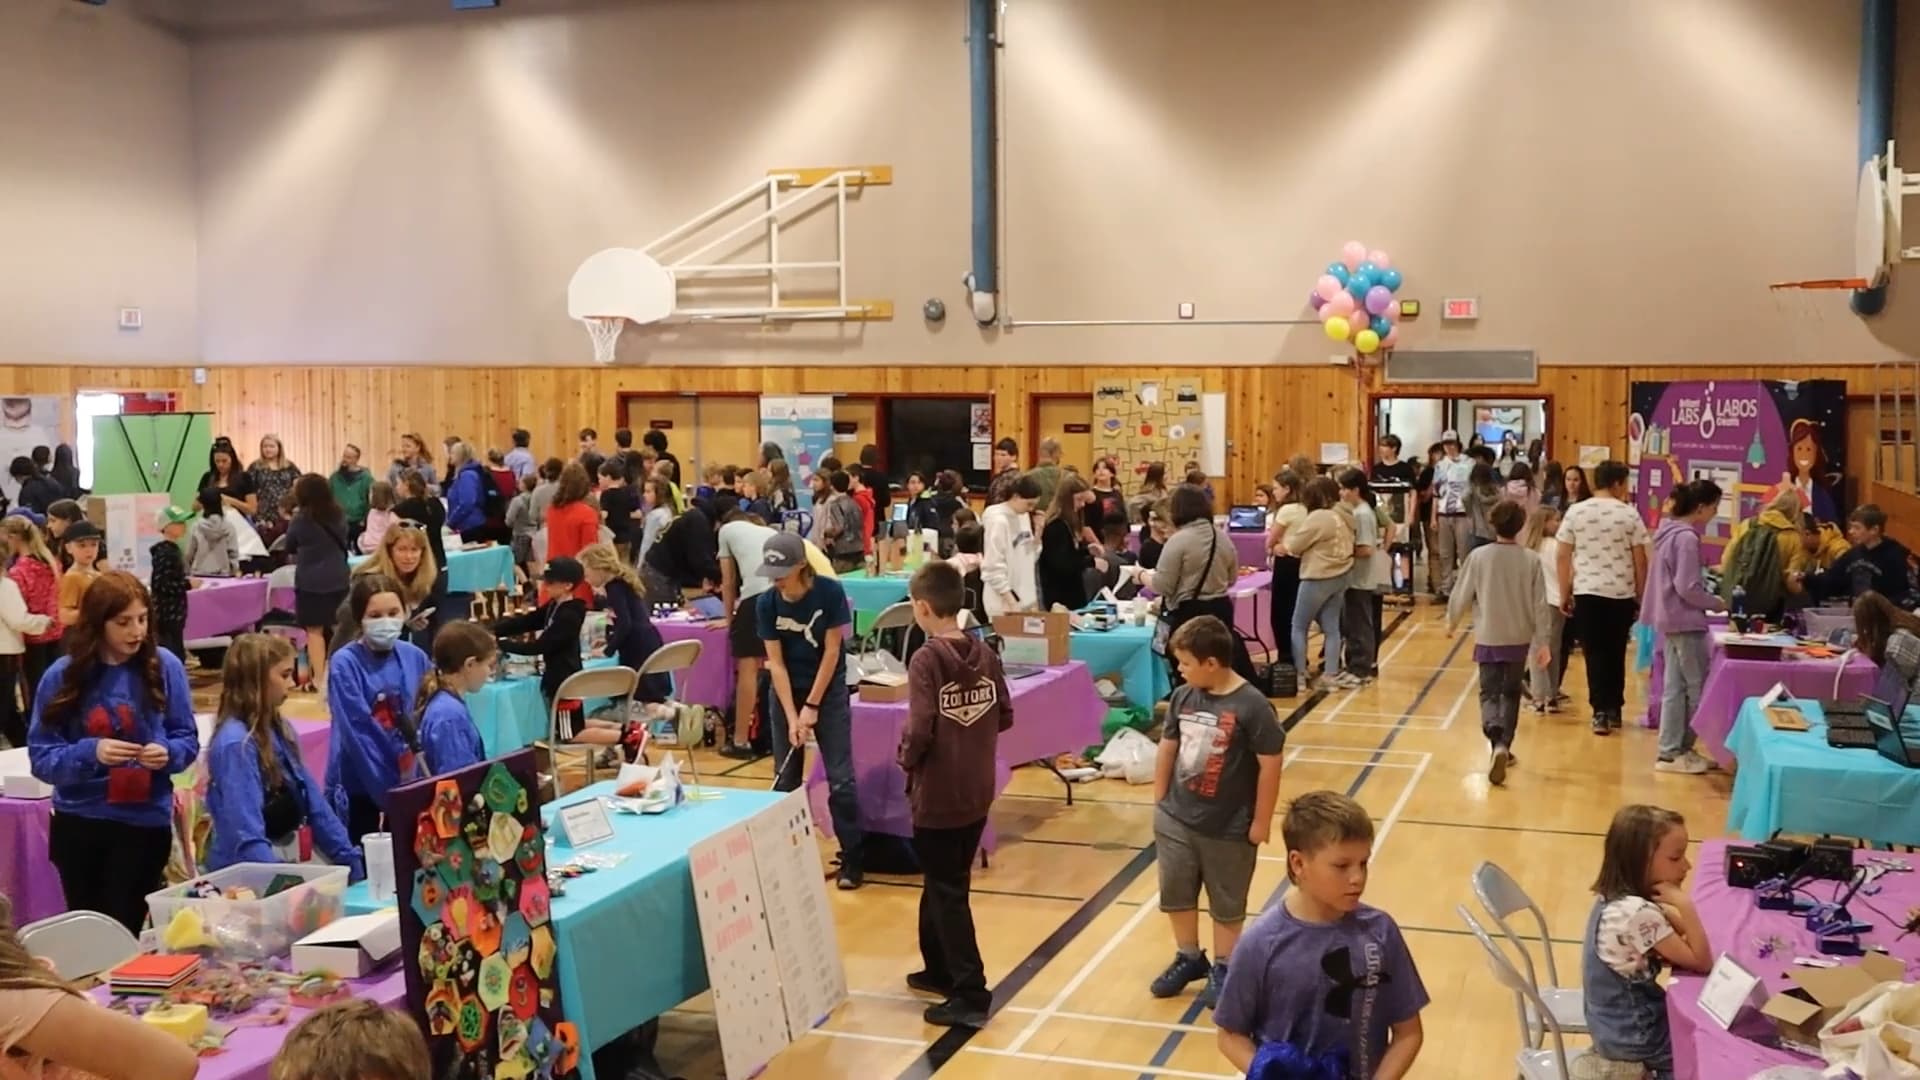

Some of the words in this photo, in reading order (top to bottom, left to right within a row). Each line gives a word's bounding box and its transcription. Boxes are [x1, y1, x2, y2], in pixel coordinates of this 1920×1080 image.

[1671, 407, 1700, 425] LABS
[1716, 398, 1757, 417] LABOS
[964, 686, 992, 704] YORK
